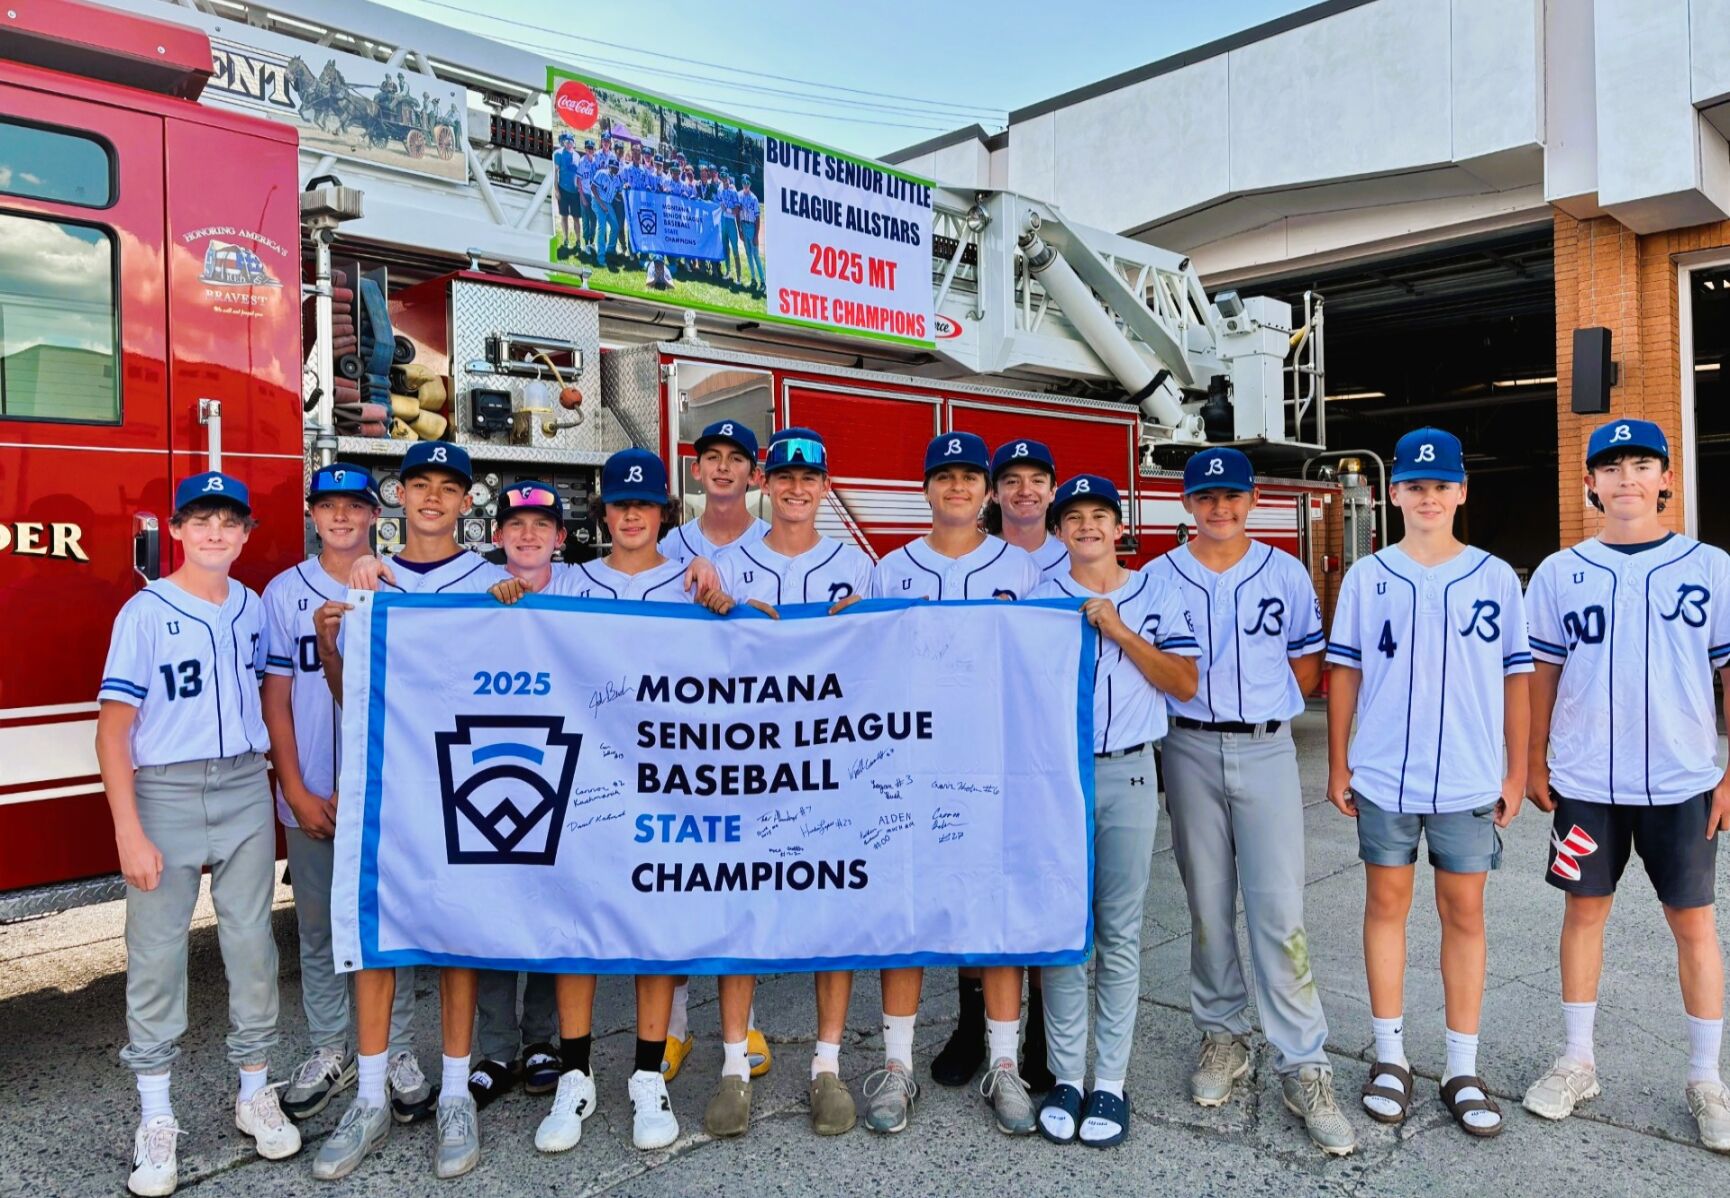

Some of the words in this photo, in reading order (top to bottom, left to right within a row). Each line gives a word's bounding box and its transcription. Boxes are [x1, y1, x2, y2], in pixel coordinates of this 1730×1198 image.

[766, 136, 821, 177] BUTTE
[824, 155, 883, 195] SENIOR
[886, 173, 931, 209] LITTLE
[664, 219, 690, 229] BASEBALL
[781, 187, 842, 227] LEAGUE
[845, 204, 921, 246] ALLSTARS
[183, 226, 236, 243] HONORING
[238, 229, 288, 257] AMERICA'S
[665, 236, 696, 246] CHAMPIONS
[810, 243, 864, 284] 2025
[868, 256, 897, 291] MT
[779, 288, 829, 321] STATE
[832, 299, 925, 338] CHAMPIONS
[719, 423, 734, 436] B
[1609, 424, 1632, 443] B
[427, 447, 447, 463] B
[944, 439, 963, 456] B
[1012, 443, 1029, 458] B
[1414, 444, 1436, 463] B
[624, 465, 643, 483] B
[1204, 458, 1224, 476] B
[202, 477, 224, 491] B
[1071, 478, 1090, 495] B
[742, 570, 754, 584] U
[901, 577, 913, 590] U
[1572, 571, 1585, 584] U
[1376, 581, 1387, 595] U
[297, 598, 309, 612] U
[1660, 582, 1711, 628] B
[1243, 597, 1285, 637] B
[1457, 598, 1501, 643] B
[166, 620, 181, 636] U
[1377, 619, 1398, 660] 4
[158, 658, 203, 702] 13
[473, 670, 552, 696] 2025
[636, 673, 844, 704] MONTANA
[637, 720, 781, 751] SENIOR
[794, 711, 933, 748] LEAGUE
[637, 758, 839, 797] BASEBALL
[879, 812, 911, 825] AIDEN
[633, 813, 741, 844] STATE
[631, 859, 869, 893] CHAMPIONS
